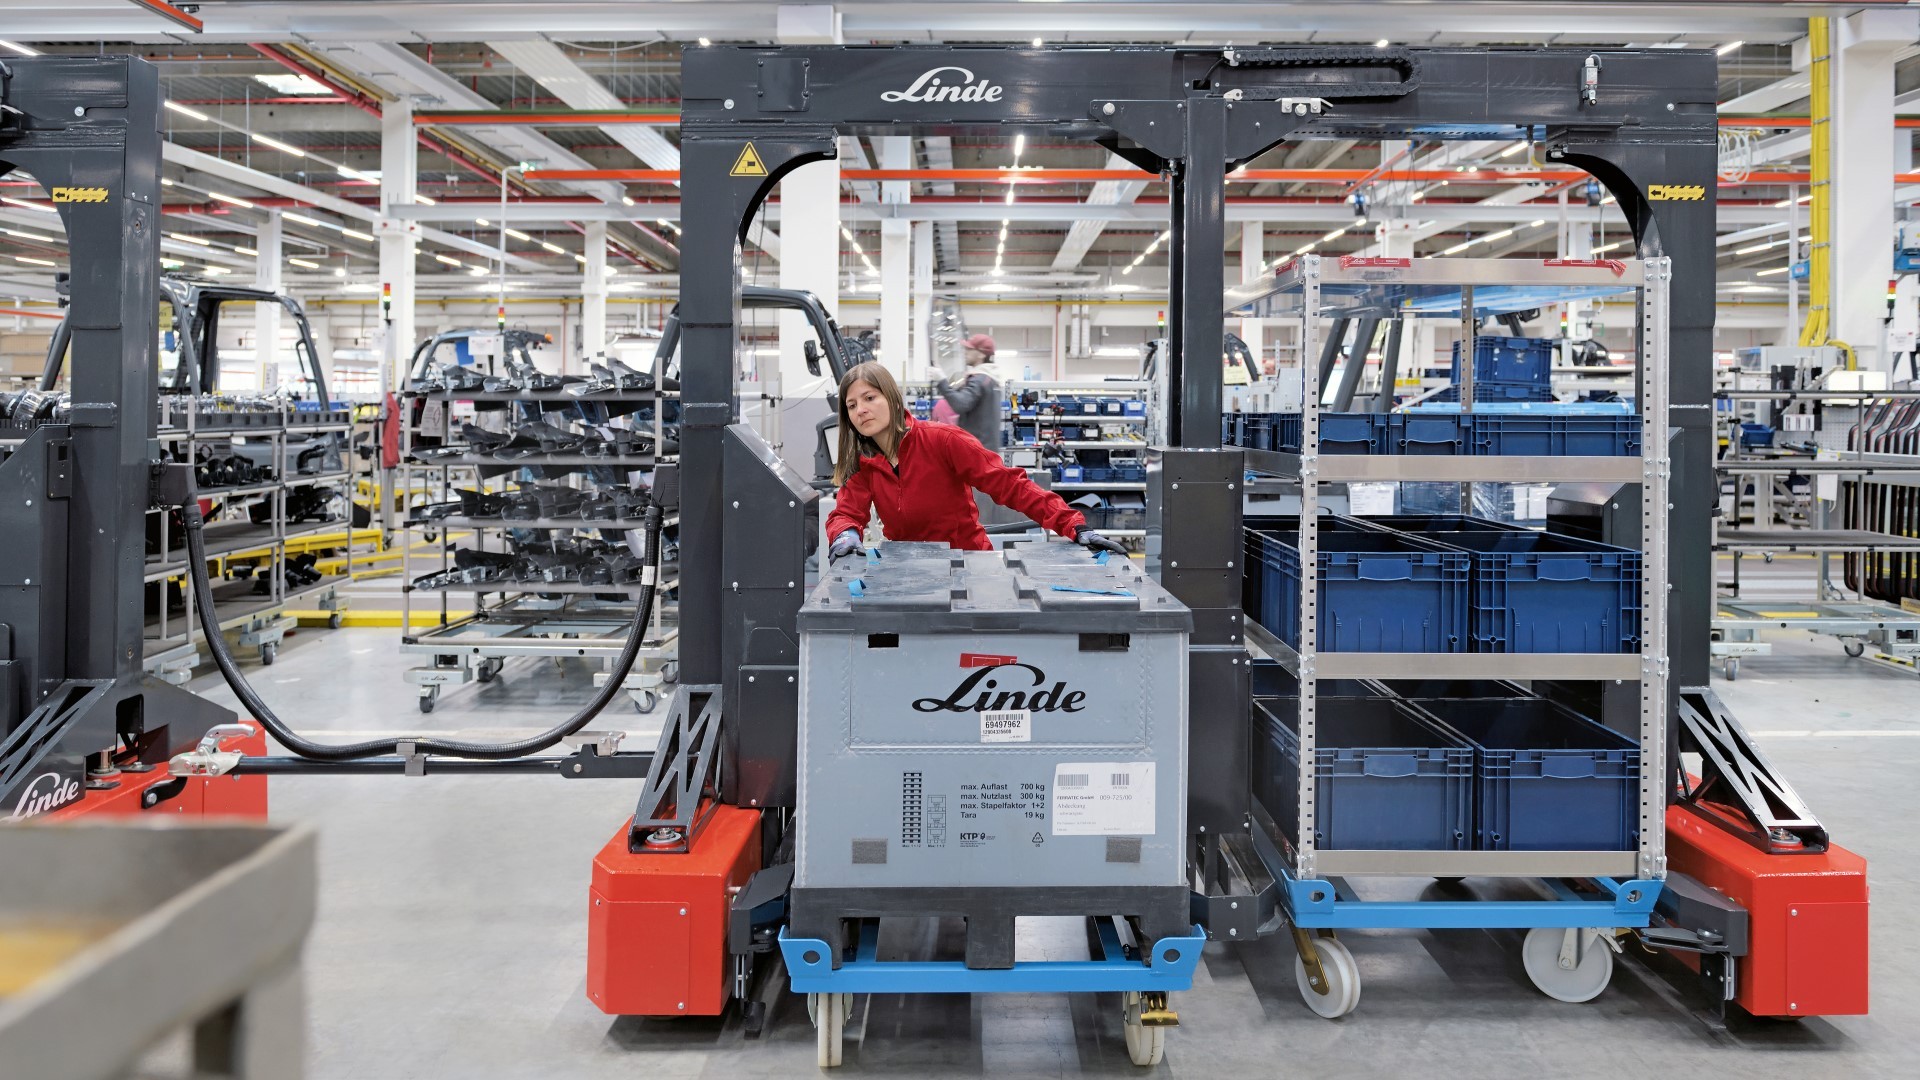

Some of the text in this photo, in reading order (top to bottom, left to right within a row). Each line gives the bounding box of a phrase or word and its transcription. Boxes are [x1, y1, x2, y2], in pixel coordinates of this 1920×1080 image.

[880, 66, 1003, 102] Linde
[912, 663, 1086, 713] Linde
[985, 720, 1021, 729] 69497962
[1035, 783, 1045, 792] kg
[0, 772, 79, 822] Linde
[1035, 793, 1045, 802] kg
[980, 802, 1027, 810] Stapelfaktor
[960, 811, 1045, 820] Tara 19 kg
[960, 832, 978, 840] KTP
